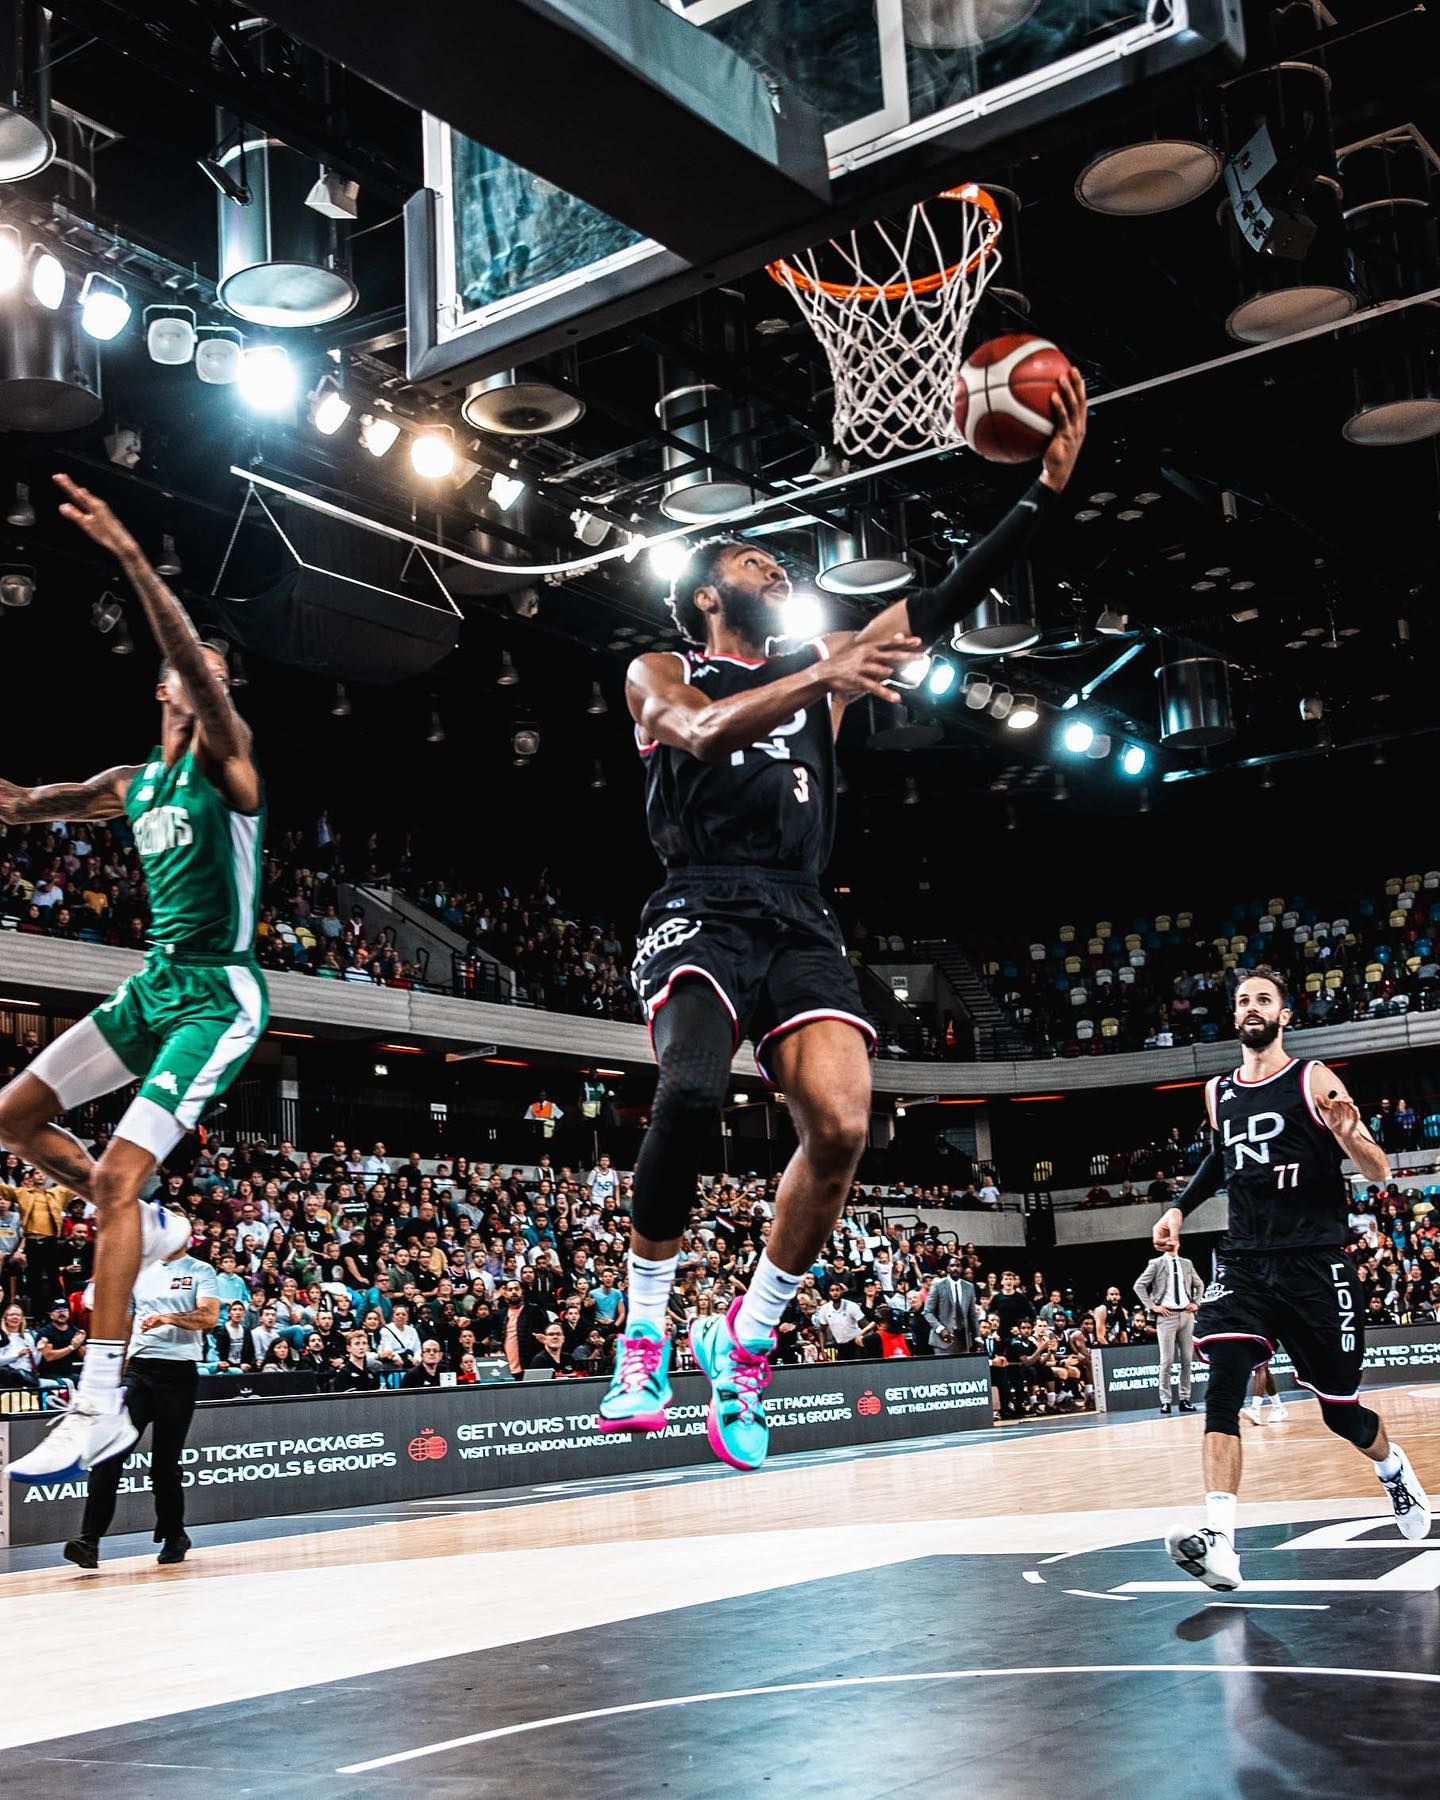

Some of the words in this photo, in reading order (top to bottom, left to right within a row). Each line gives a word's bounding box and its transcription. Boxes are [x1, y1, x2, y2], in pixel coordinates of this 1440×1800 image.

[792, 766, 809, 803] 3
[1273, 1163, 1300, 1190] 77
[1330, 1263, 1356, 1352] LIONS
[784, 1392, 844, 1410] PACKAGES
[885, 1386, 910, 1401] GET
[910, 1382, 949, 1398] YOURS
[948, 1378, 988, 1395] TODAY!
[806, 1407, 852, 1424] GROUPS
[886, 1404, 908, 1416] VISIT
[457, 1422, 497, 1441] GET
[500, 1415, 564, 1438] YOURS
[646, 1422, 709, 1440] AVAILABL
[201, 1441, 278, 1463] TICKET
[280, 1432, 385, 1456] PACKAGES
[459, 1445, 492, 1460] VISIT
[492, 1432, 632, 1457] THELONDONLIONS.COM
[24, 1476, 153, 1503] AVAILBLE
[198, 1460, 301, 1486] SCHOOLS
[303, 1461, 317, 1475] &
[318, 1451, 397, 1474] GROUPS
